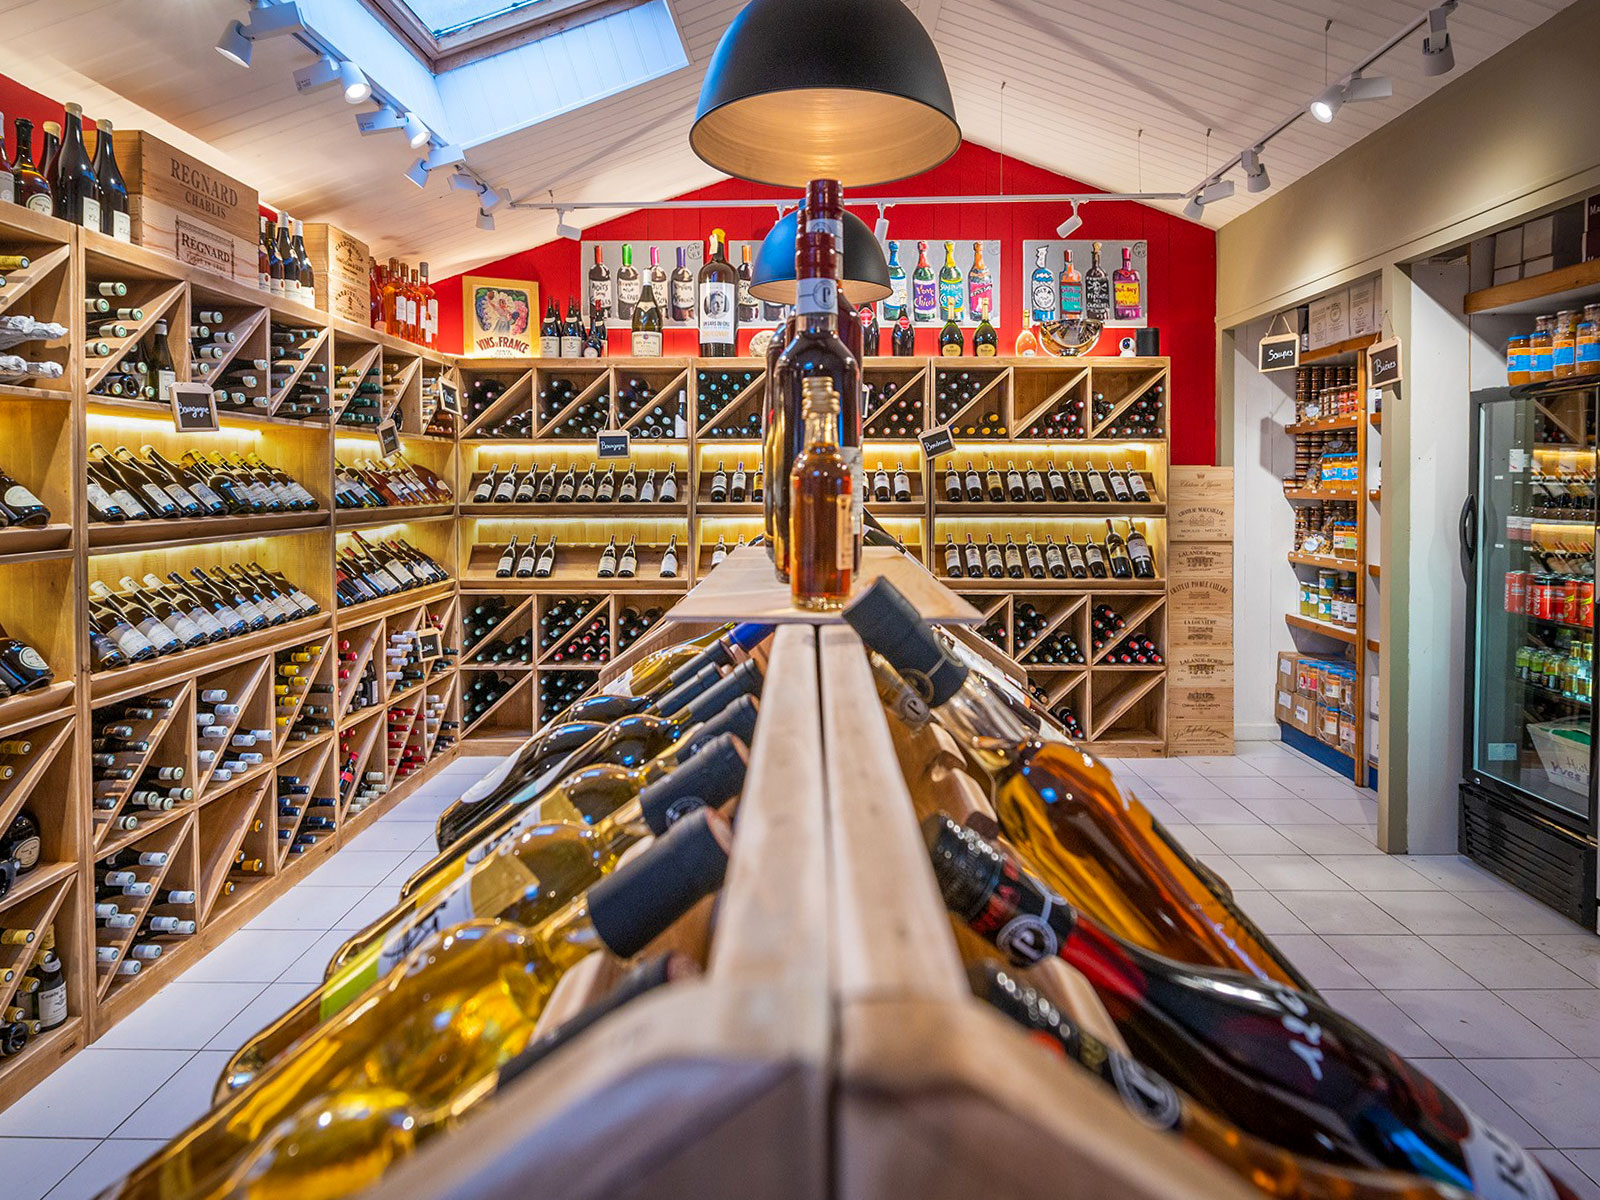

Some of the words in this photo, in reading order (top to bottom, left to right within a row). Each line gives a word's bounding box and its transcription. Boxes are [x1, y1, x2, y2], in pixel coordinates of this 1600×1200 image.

[171, 158, 238, 207] REGNARD
[185, 191, 226, 219] CHABLIS
[476, 337, 494, 351] VINS
[499, 336, 530, 354] FRANCE
[1267, 349, 1293, 362] Soupes
[1551, 760, 1581, 782] Yves
